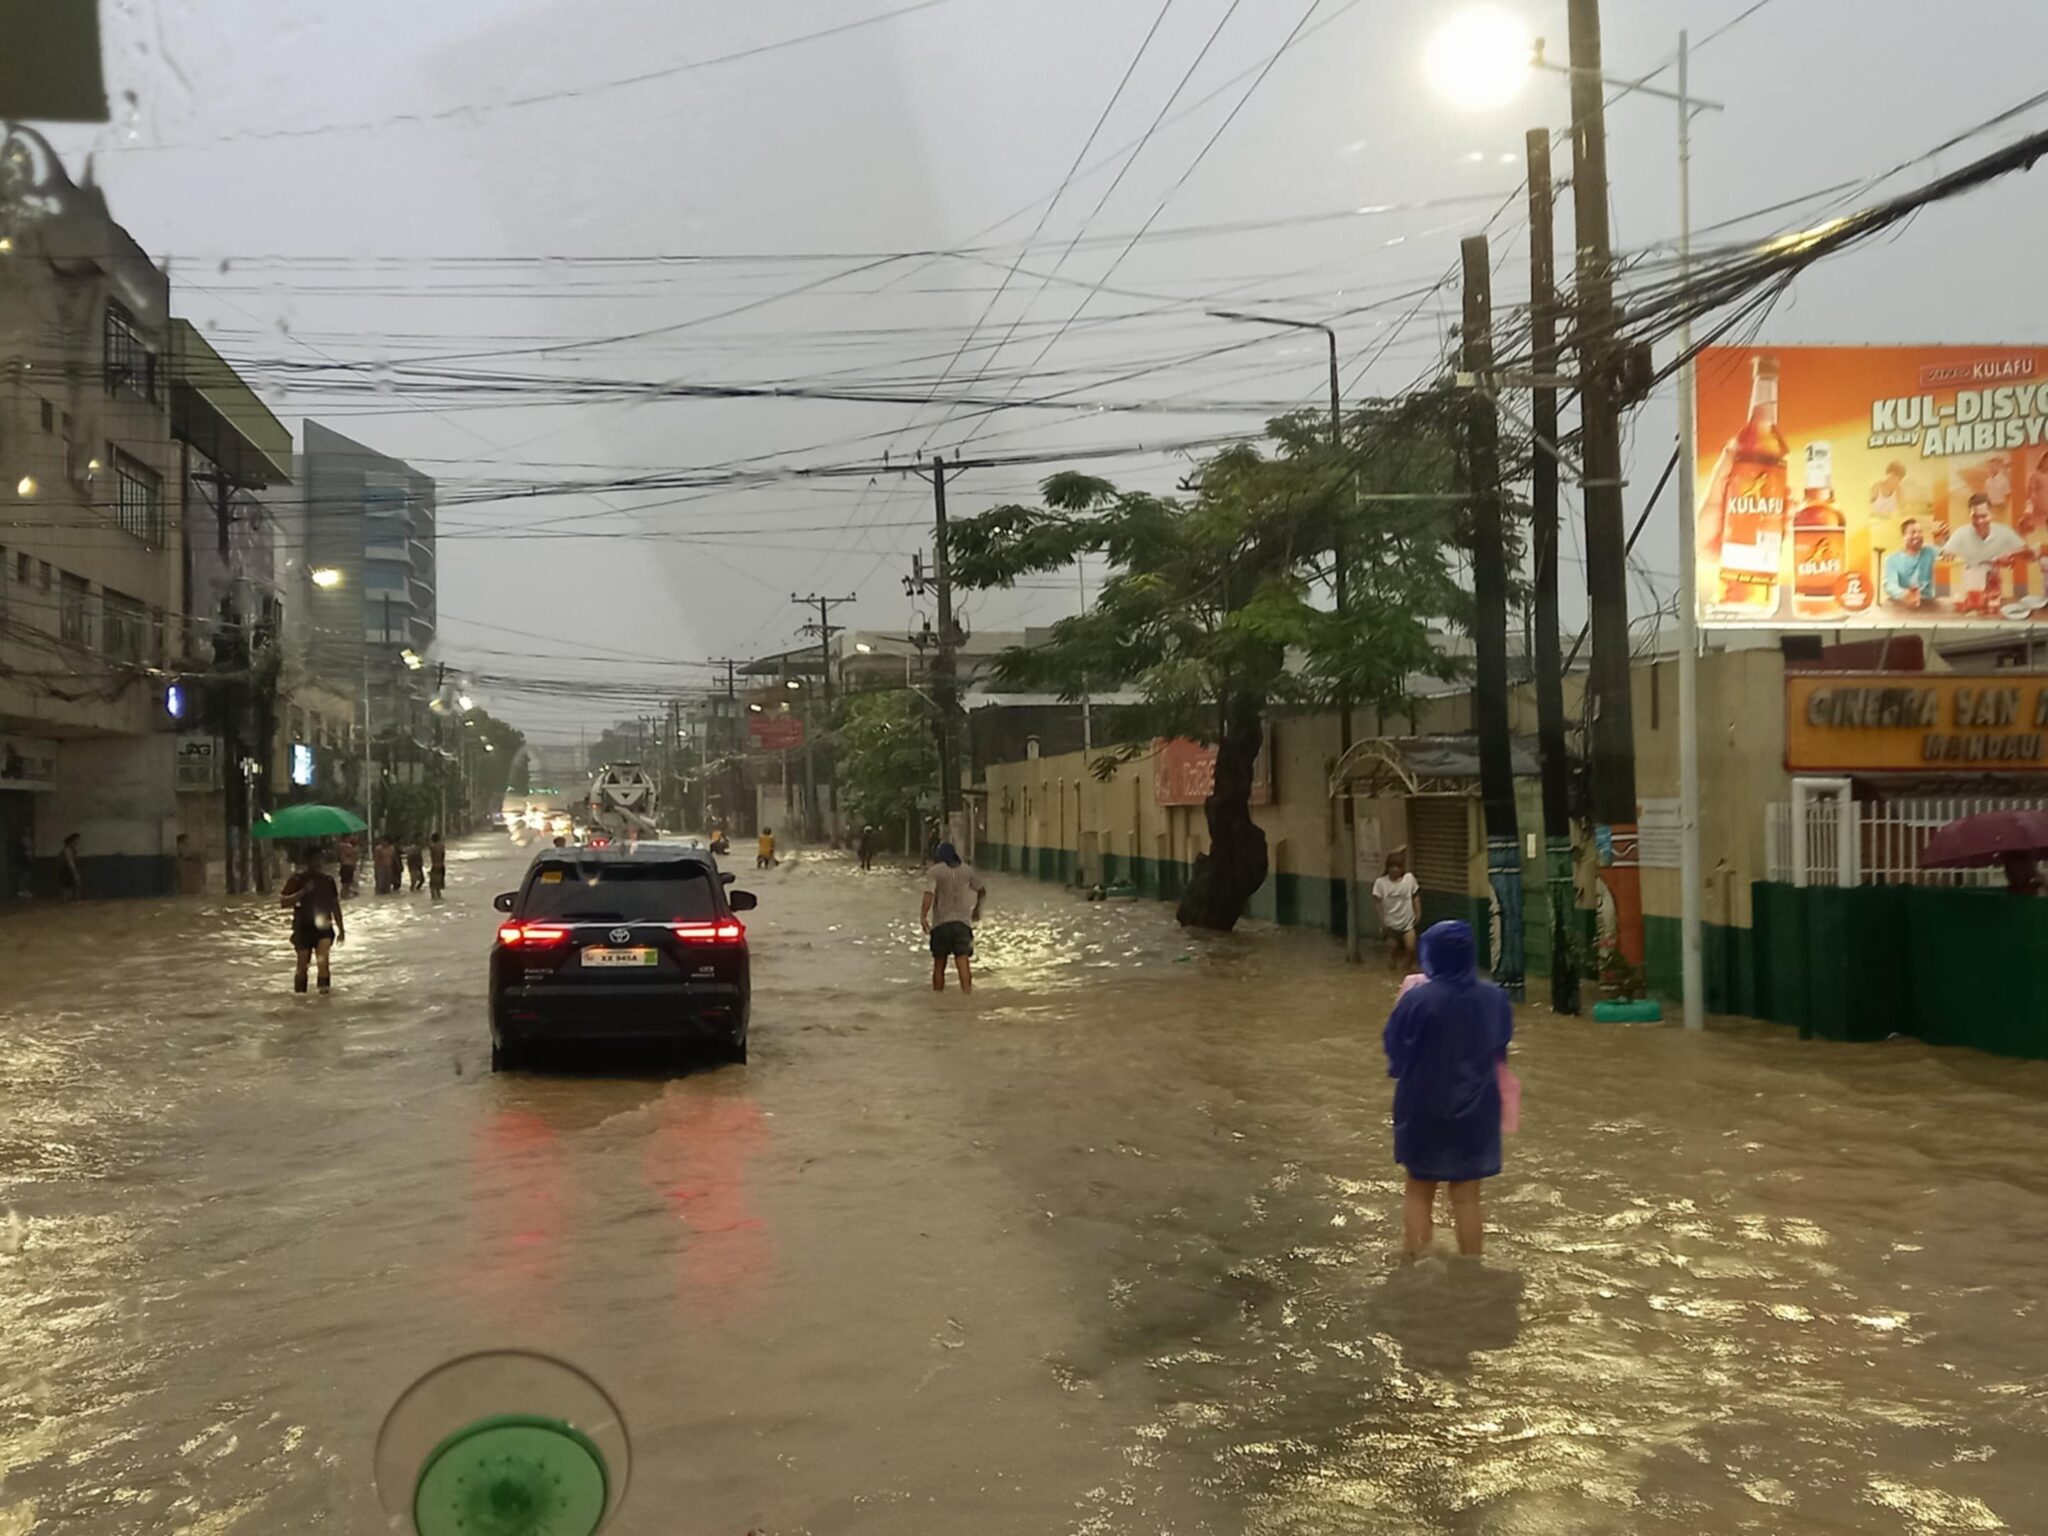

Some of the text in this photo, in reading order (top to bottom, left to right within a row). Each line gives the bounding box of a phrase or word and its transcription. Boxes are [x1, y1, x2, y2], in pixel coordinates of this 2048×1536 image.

[1973, 359, 2033, 378] KULAFU
[1922, 416, 2048, 456] AMBISY
[1728, 496, 1784, 514] KULAFU
[1953, 686, 2022, 727] SAN
